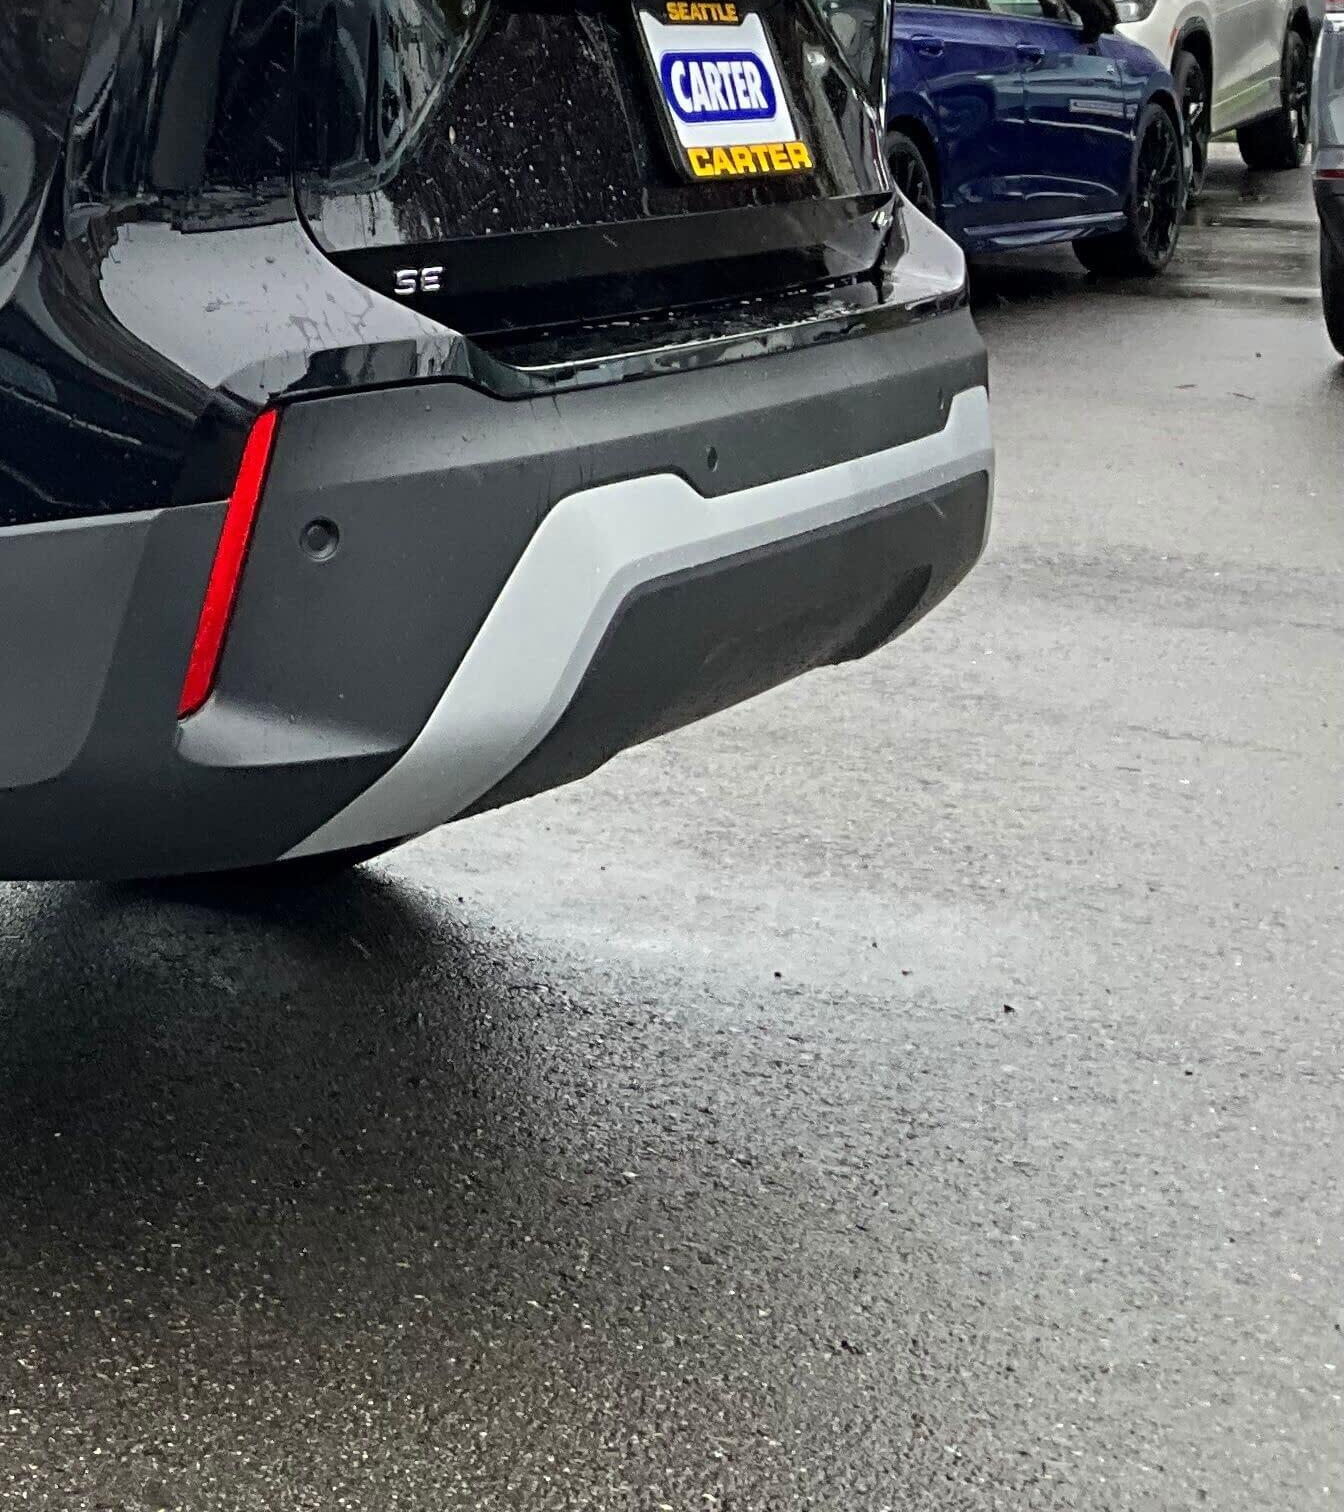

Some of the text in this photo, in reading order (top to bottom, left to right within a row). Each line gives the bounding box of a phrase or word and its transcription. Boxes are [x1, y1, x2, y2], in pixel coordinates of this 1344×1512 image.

[666, 1, 738, 22] SEATTLE
[670, 60, 769, 113] CARTER
[687, 142, 813, 177] CARTER
[394, 266, 443, 295] SE
